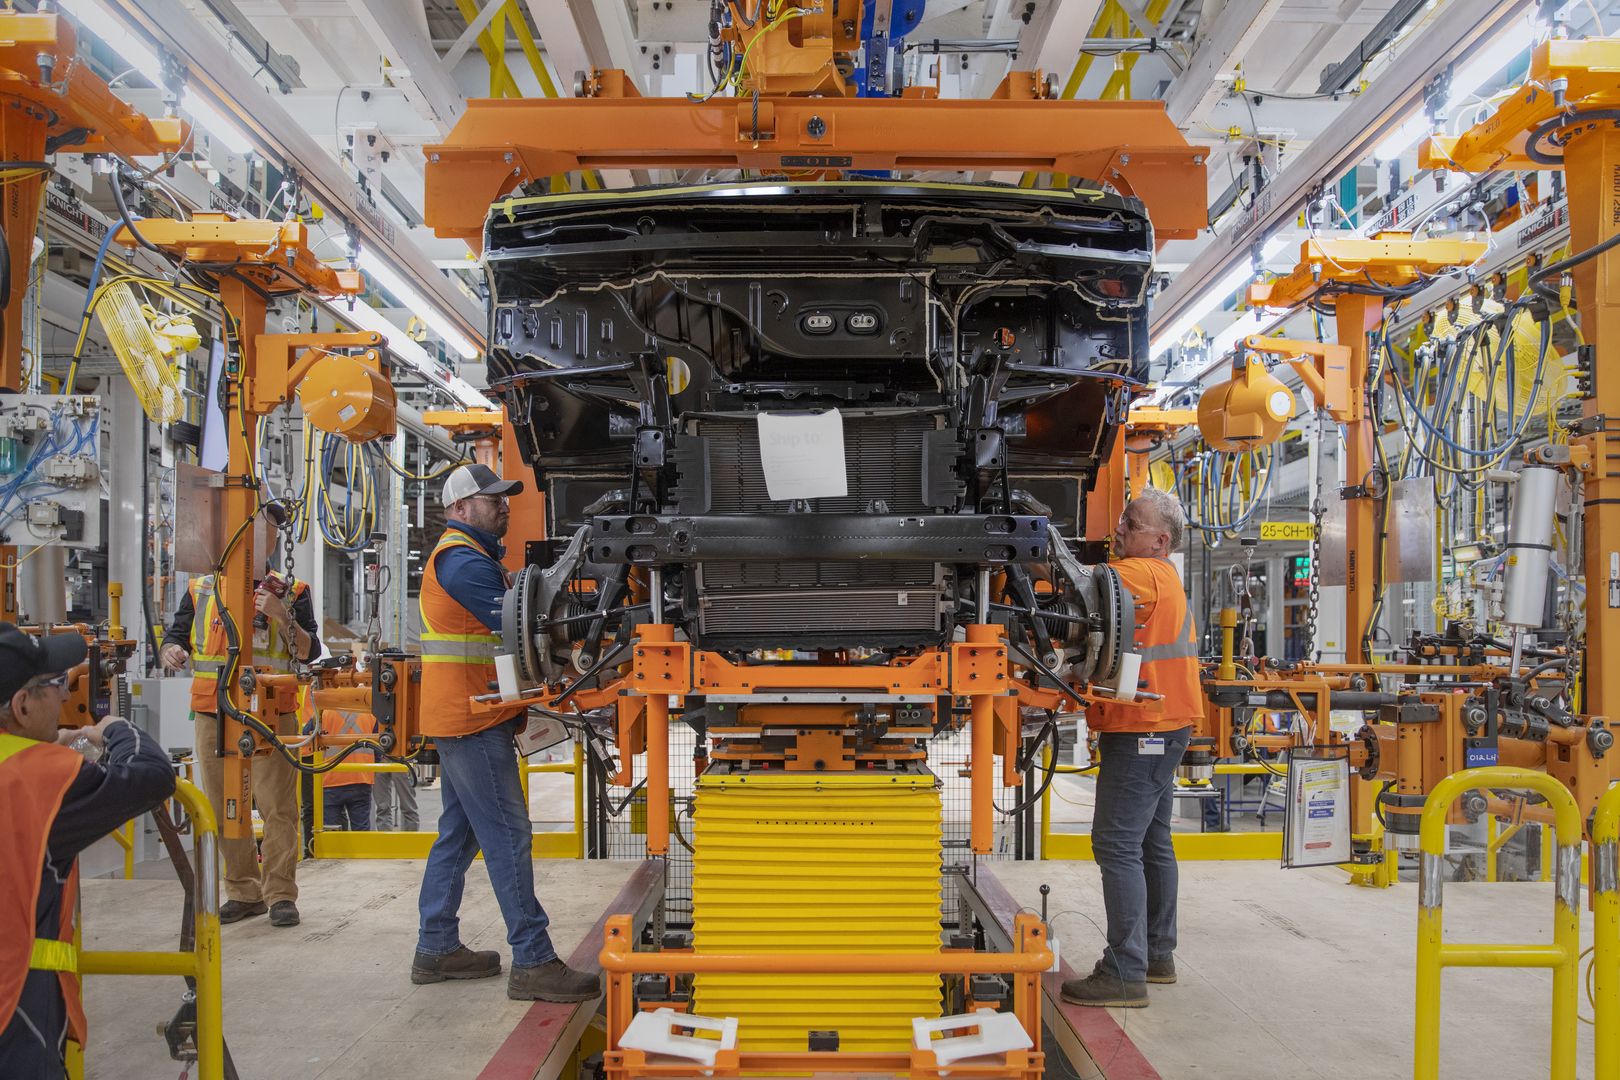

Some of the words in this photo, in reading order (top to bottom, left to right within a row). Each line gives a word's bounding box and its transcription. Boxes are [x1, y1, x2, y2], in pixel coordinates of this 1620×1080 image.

[50, 194, 84, 220] KNIGHT
[1521, 211, 1554, 238] KNIGHT
[768, 431, 800, 449] Ship
[1486, 753, 1497, 761] LH
